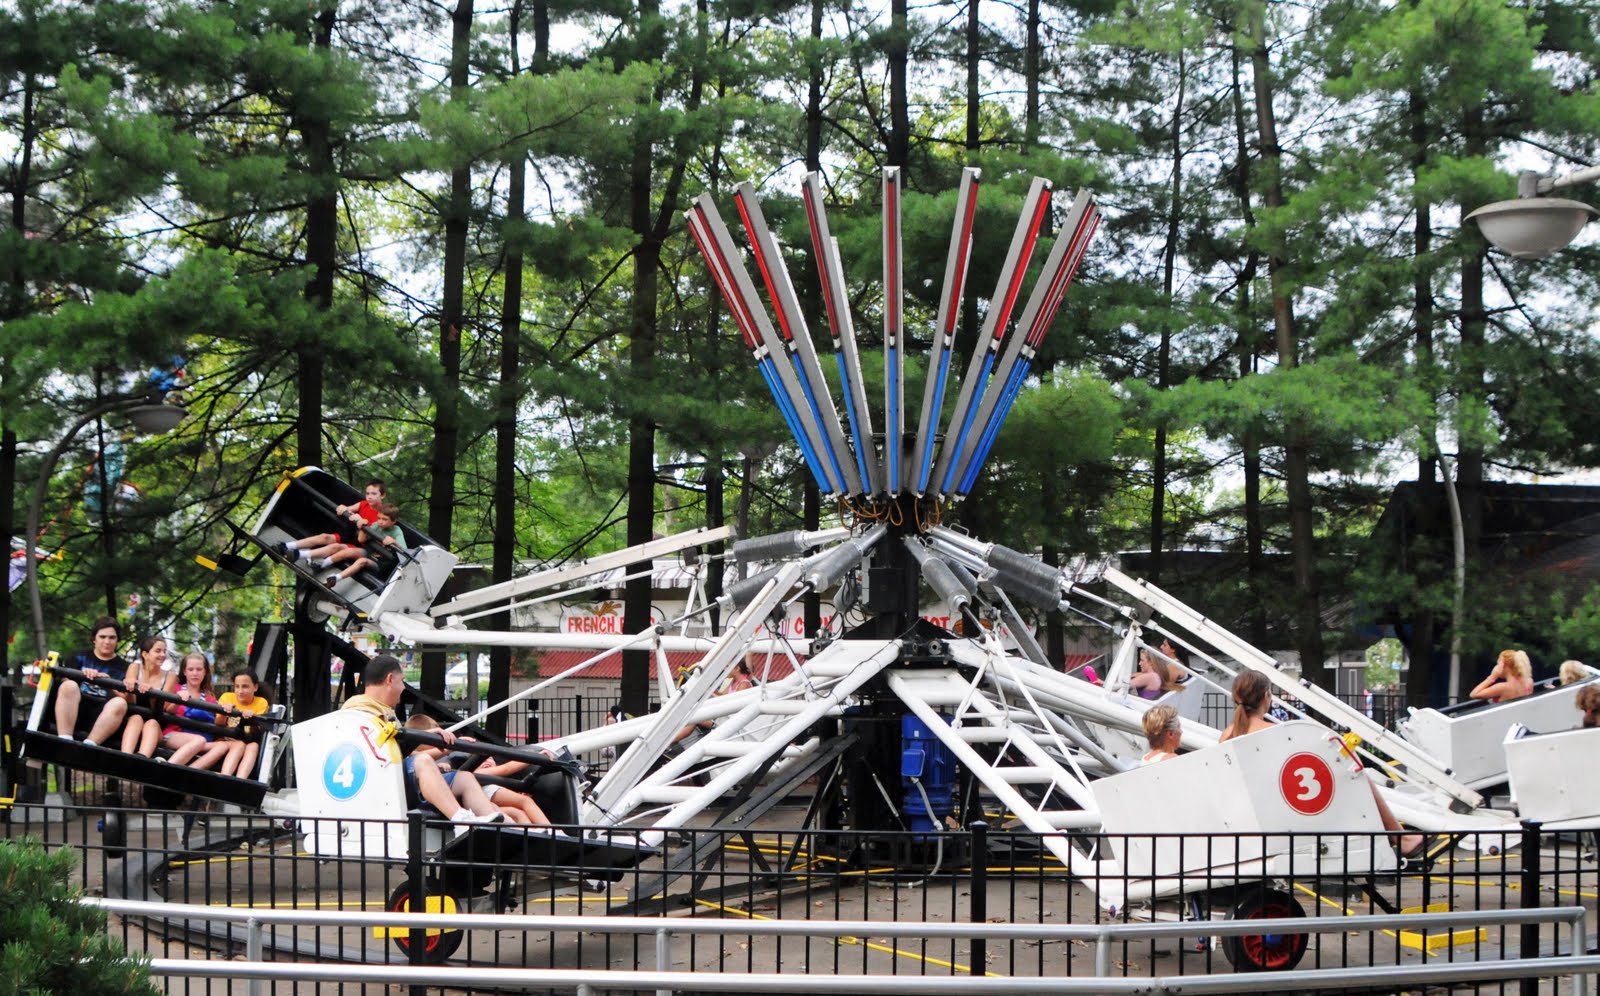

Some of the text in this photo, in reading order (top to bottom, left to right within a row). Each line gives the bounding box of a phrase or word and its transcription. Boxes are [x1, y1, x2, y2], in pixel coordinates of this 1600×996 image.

[567, 616, 616, 633] FRENCH
[921, 615, 951, 631] OT
[332, 752, 354, 788] 4
[1293, 766, 1322, 801] 3
